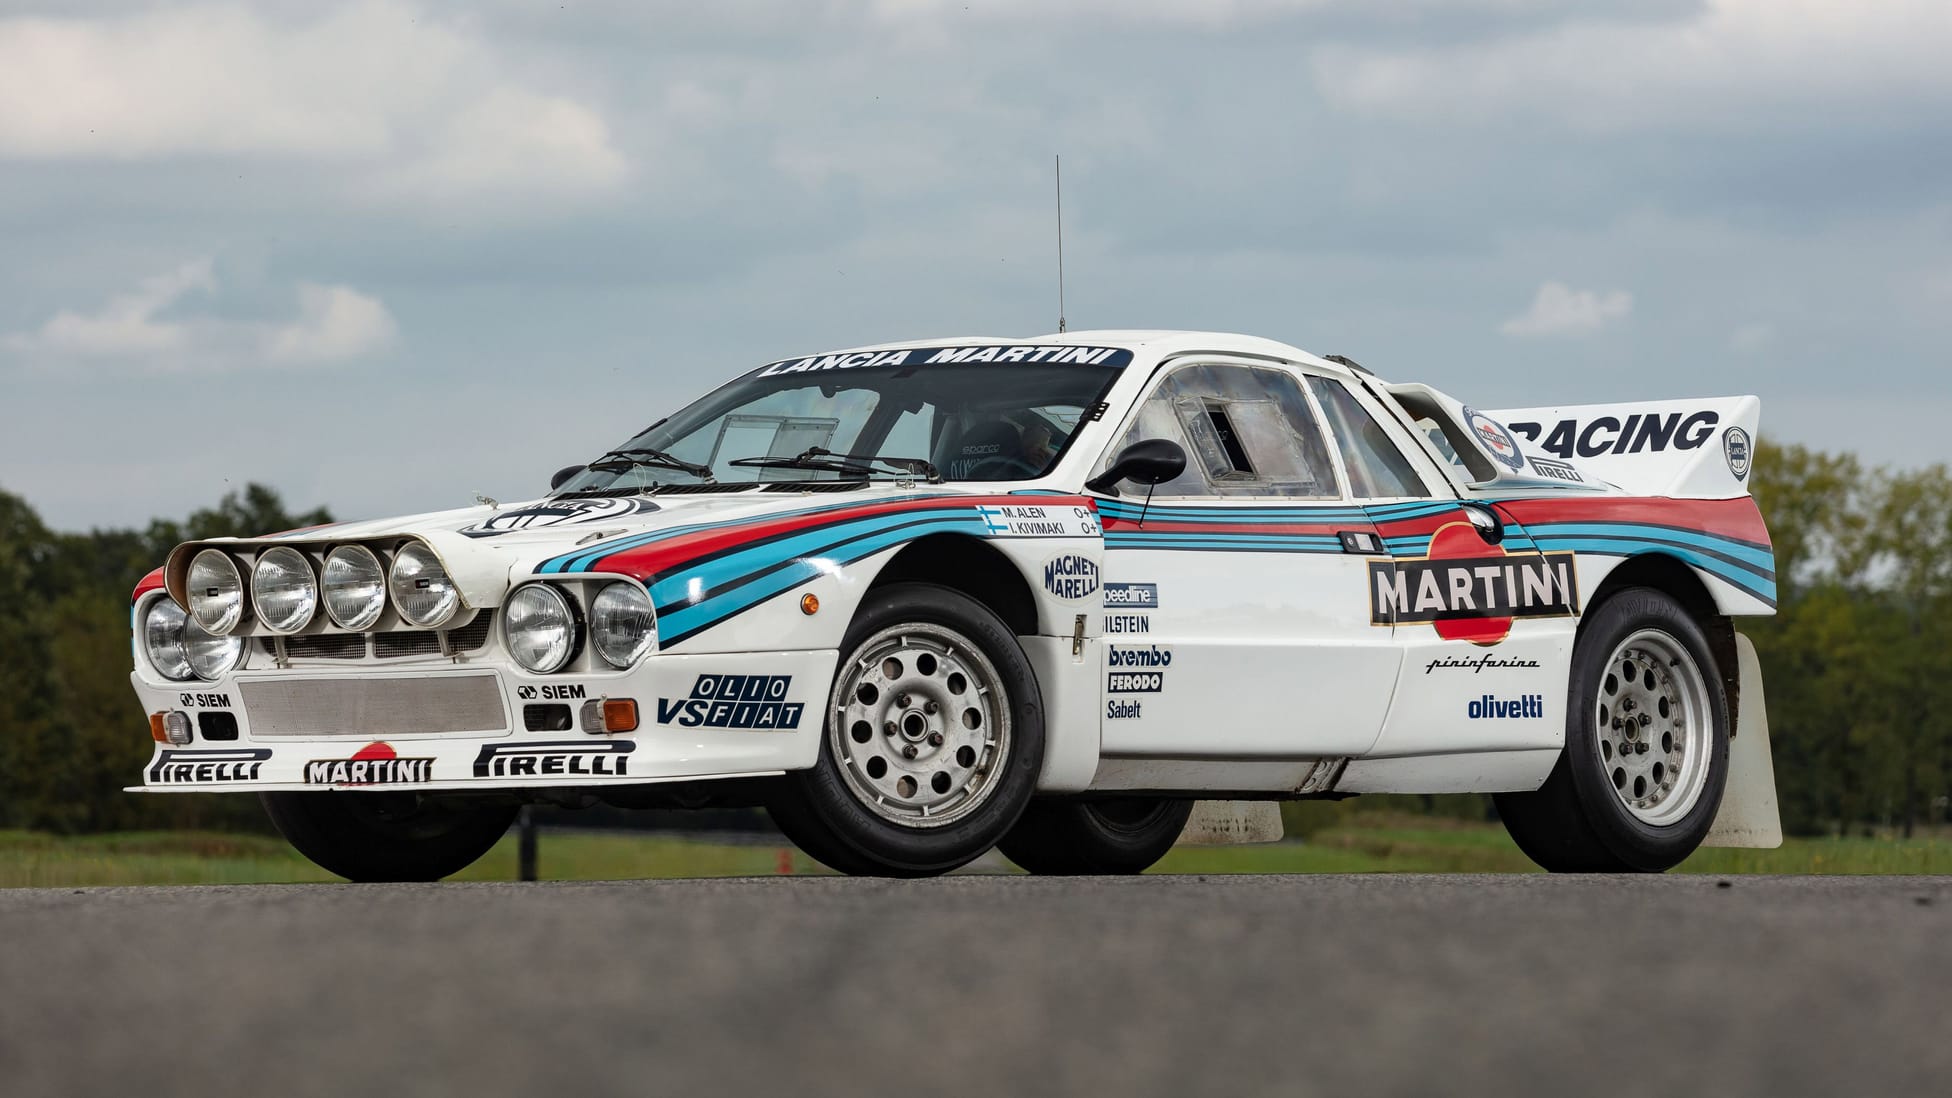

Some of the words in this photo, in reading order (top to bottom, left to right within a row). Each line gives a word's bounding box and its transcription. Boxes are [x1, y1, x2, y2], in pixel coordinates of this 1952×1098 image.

[758, 351, 911, 378] LANCIA
[924, 346, 1113, 365] MARTINI
[1525, 456, 1584, 482] PIRELLI
[1045, 556, 1099, 582] MAGNETI
[1045, 571, 1099, 599] MARELLI
[1103, 585, 1151, 604] peedline
[1376, 562, 1570, 614] MARTINI
[1103, 616, 1149, 633] ILSTEIN
[1109, 645, 1171, 666] brembo
[1426, 654, 1540, 674] pininfarina
[542, 684, 586, 699] SIEM
[699, 678, 785, 697] OLIO
[1109, 675, 1161, 692] FERODO
[197, 694, 231, 708] SIEM
[1107, 700, 1141, 719] Sabelt
[1468, 695, 1542, 719] olivetti
[150, 748, 273, 783] PIRELLI
[473, 740, 636, 777] PIRELLI
[308, 760, 430, 784] MARTINI
